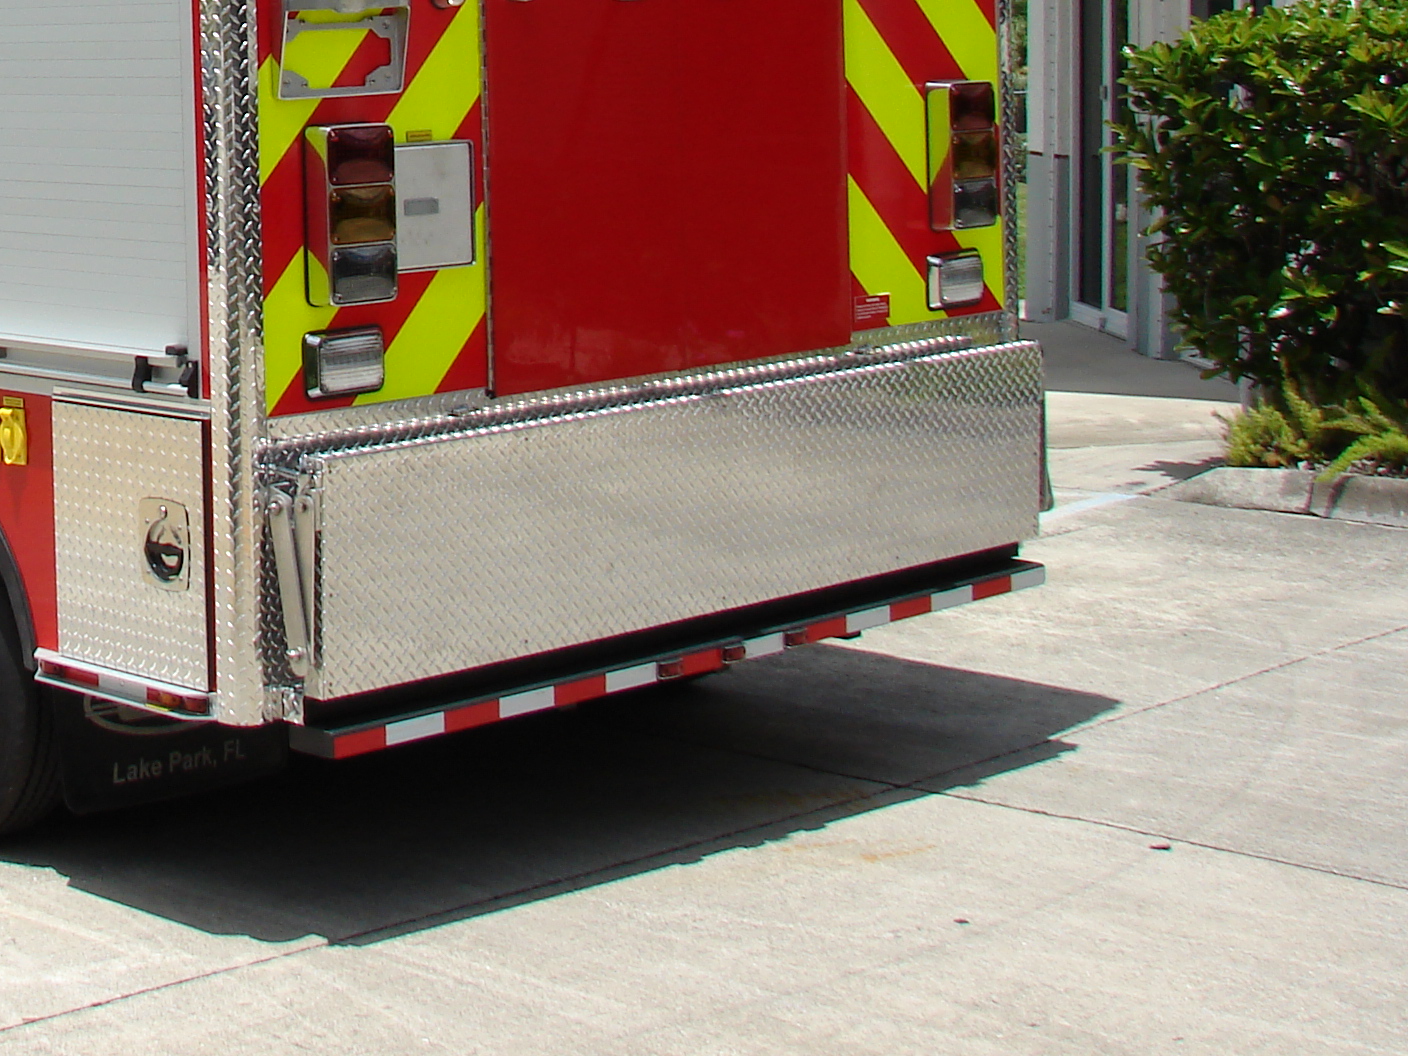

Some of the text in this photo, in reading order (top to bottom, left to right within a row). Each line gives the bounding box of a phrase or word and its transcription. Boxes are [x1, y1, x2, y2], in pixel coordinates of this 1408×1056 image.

[113, 739, 247, 784] Lake Park, FL
